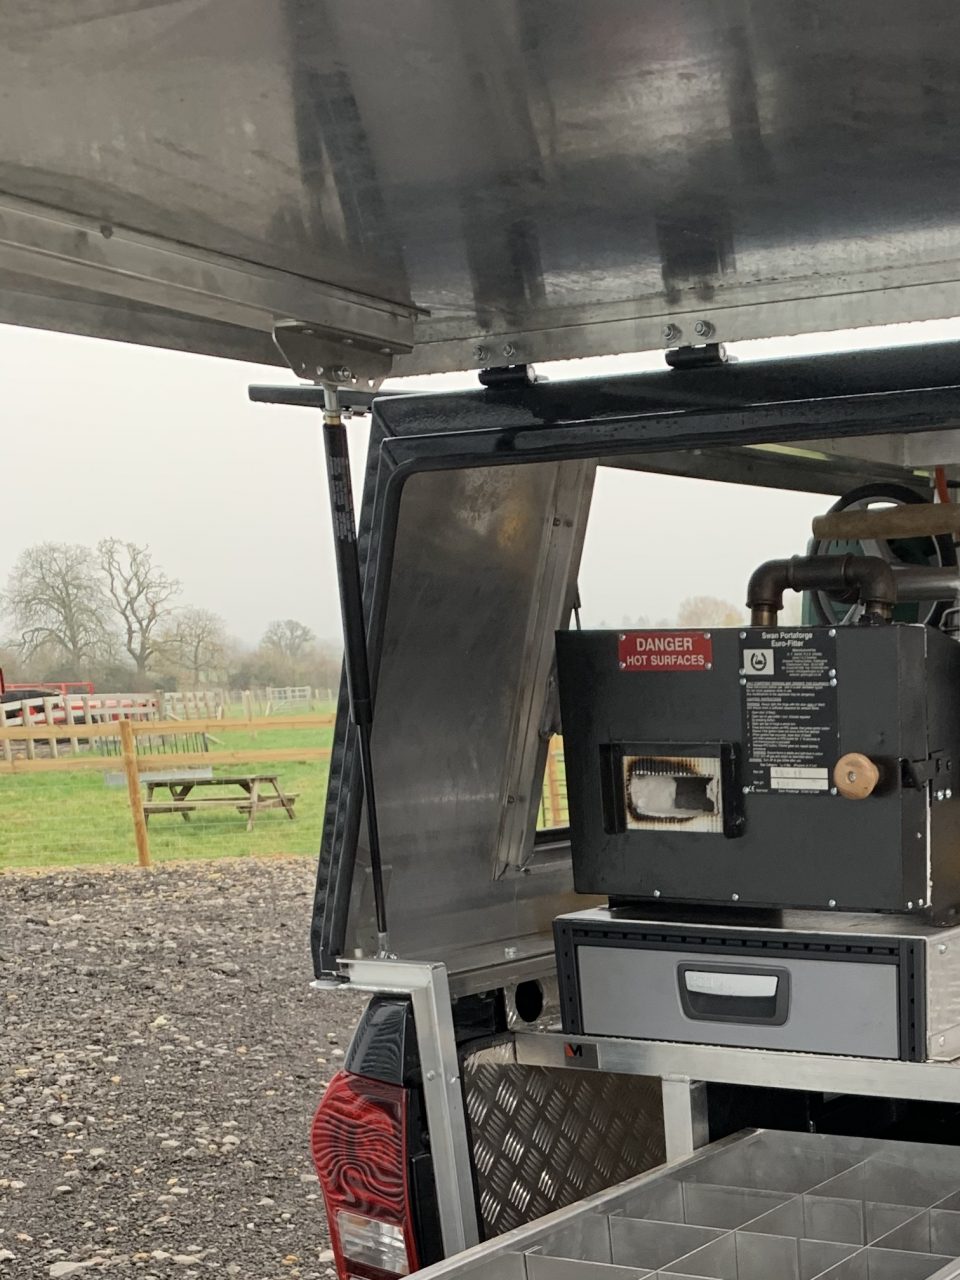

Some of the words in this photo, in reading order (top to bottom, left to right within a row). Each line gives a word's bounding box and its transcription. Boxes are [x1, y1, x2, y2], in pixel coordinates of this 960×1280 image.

[761, 631, 779, 639] Swan
[780, 631, 813, 640] Portaforge
[636, 637, 693, 651] DANGER
[626, 655, 648, 666] HOT
[650, 654, 705, 666] SURFACES
